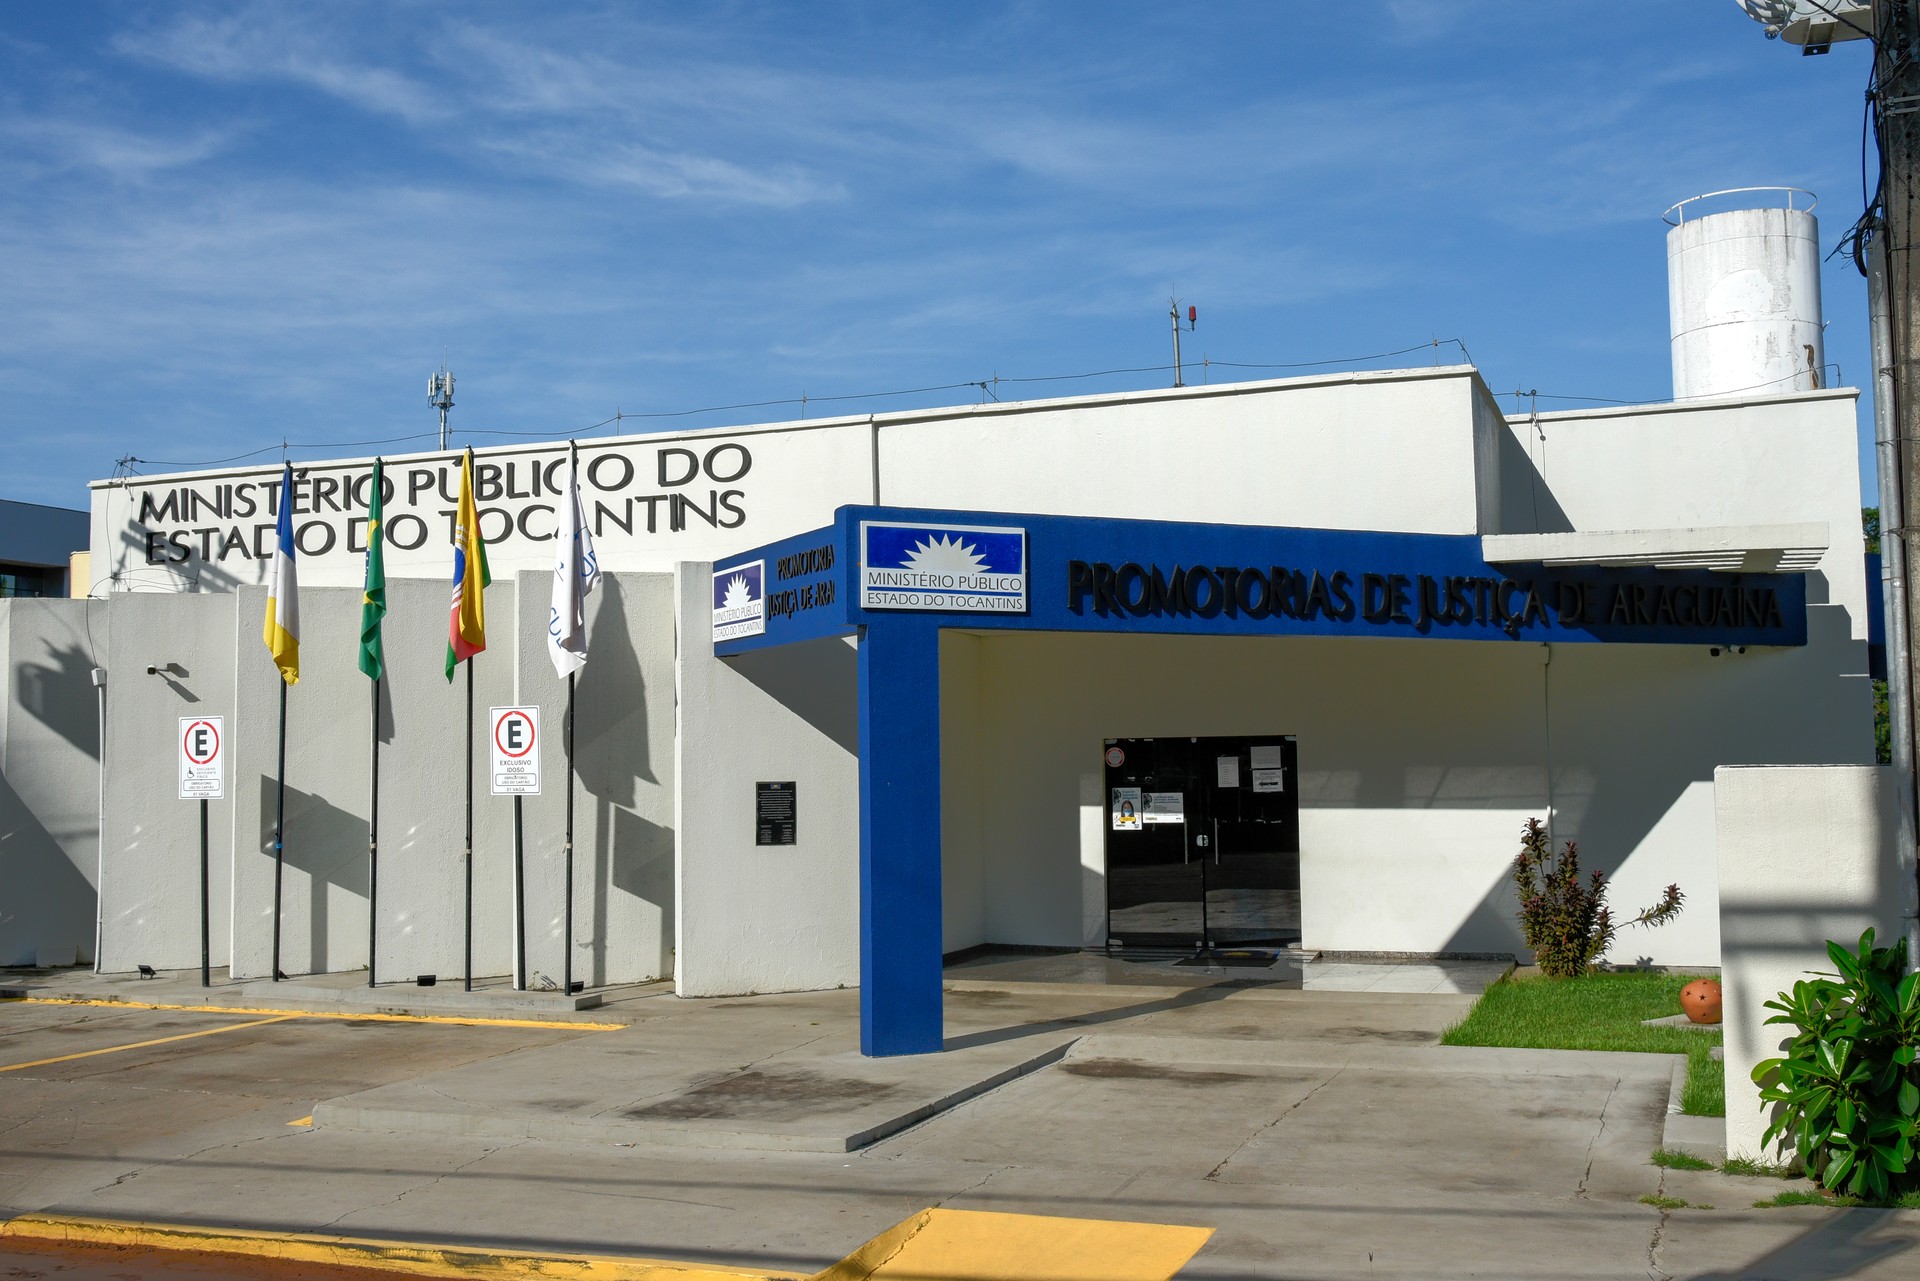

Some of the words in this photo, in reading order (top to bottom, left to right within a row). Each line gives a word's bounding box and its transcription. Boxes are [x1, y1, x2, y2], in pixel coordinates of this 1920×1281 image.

[138, 467, 395, 523] MINISTÉRIO
[657, 443, 752, 487] DO
[145, 520, 337, 566] ESTADO
[346, 513, 429, 553] DO
[438, 489, 746, 546] TOCNTINS
[868, 571, 955, 589] MINISTÉRIO
[958, 574, 1022, 591] PÚBLICO
[768, 588, 800, 621] JUSTIÇA
[801, 584, 814, 610] DE
[867, 592, 920, 606] ESTADO
[924, 594, 945, 607] DO
[948, 595, 1023, 610] TOCANTINS
[1067, 560, 1351, 617] PROMOTORIAS
[1362, 572, 1408, 619] DE
[1415, 573, 1548, 632] JUSTIÇA
[1558, 582, 1596, 625] DE
[1609, 577, 1783, 627] ARAGUAÍNA
[713, 607, 741, 623] MINISTÉRIO
[741, 602, 763, 619] PÚBLICO
[713, 626, 730, 639] ESTADO
[730, 625, 738, 636] DO
[740, 620, 763, 634] TOCANTINS
[195, 729, 208, 756] E
[507, 720, 522, 748] E
